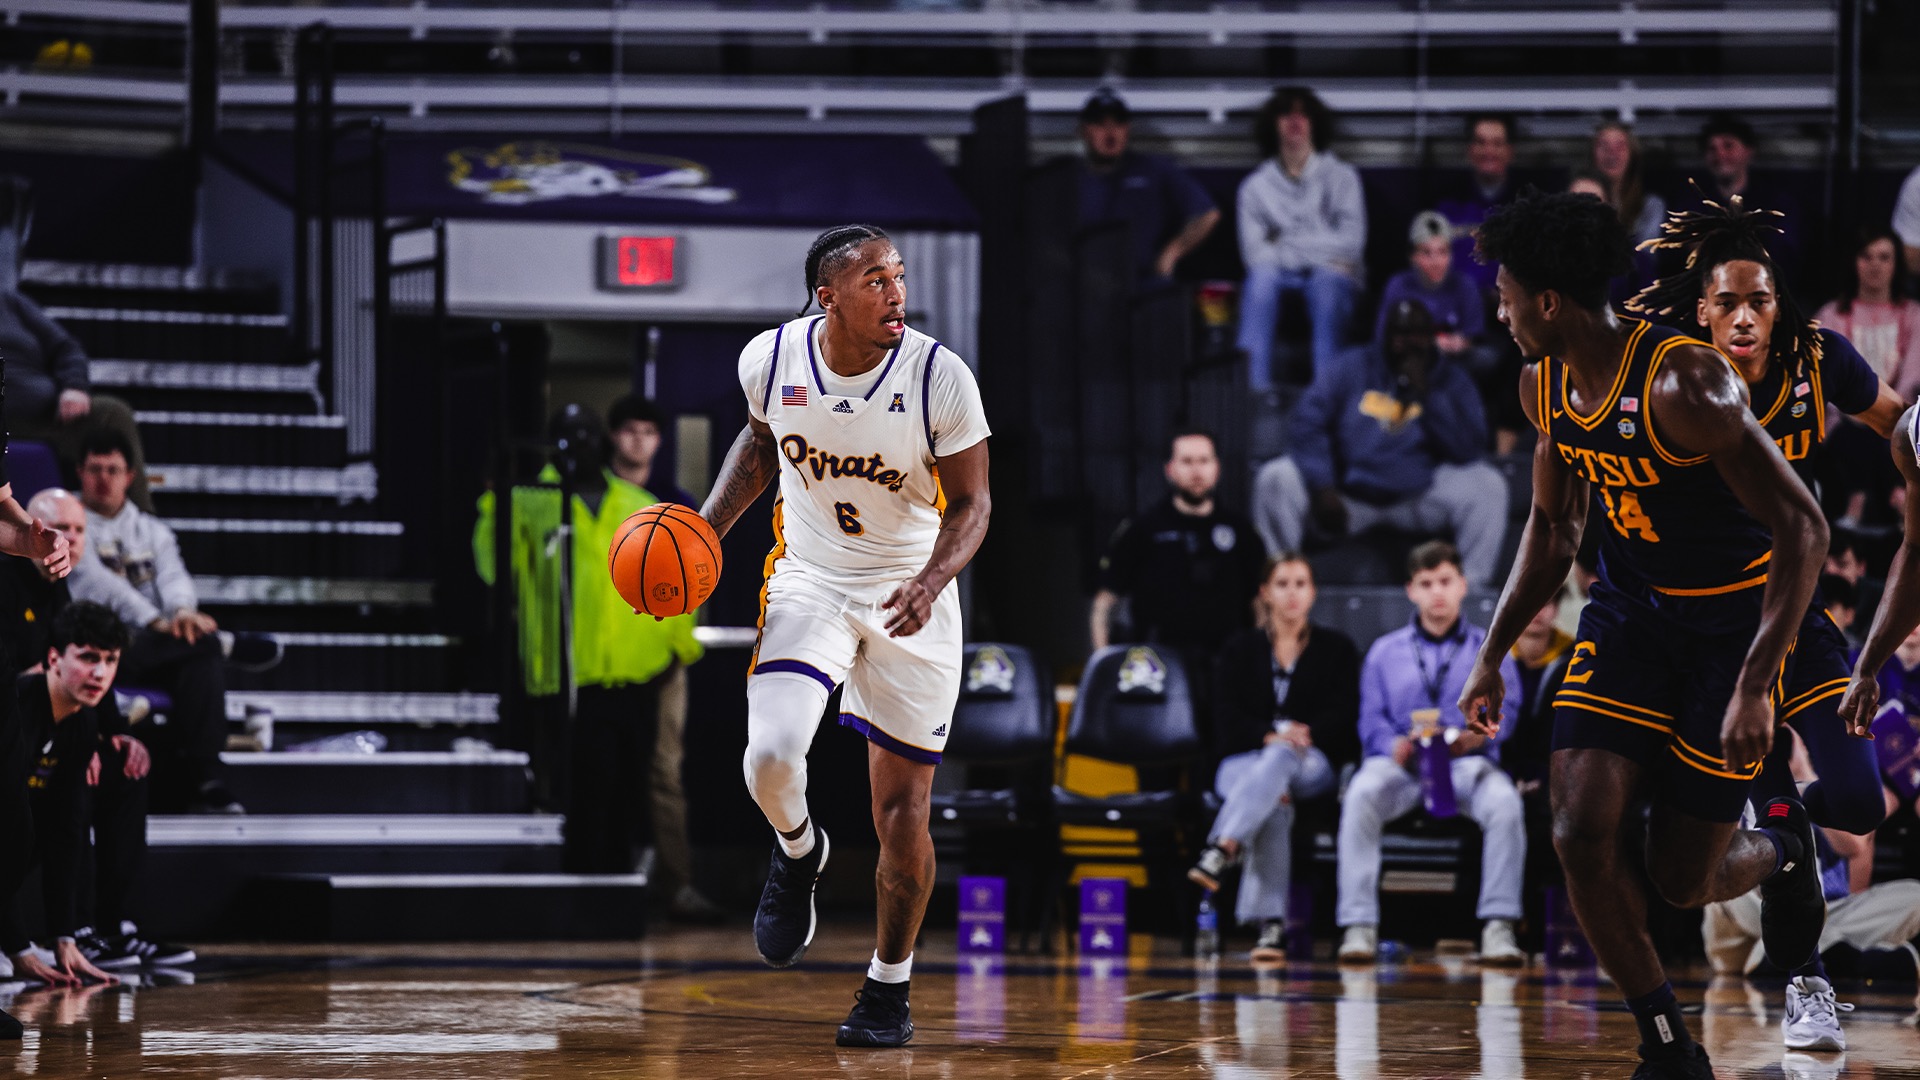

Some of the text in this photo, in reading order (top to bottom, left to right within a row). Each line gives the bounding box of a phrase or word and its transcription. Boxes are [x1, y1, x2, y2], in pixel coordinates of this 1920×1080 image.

[780, 433, 908, 493] Pirates
[1557, 442, 1660, 487] ETSU
[834, 500, 865, 536] 6
[1600, 486, 1660, 543] 14
[1562, 640, 1597, 685] E
